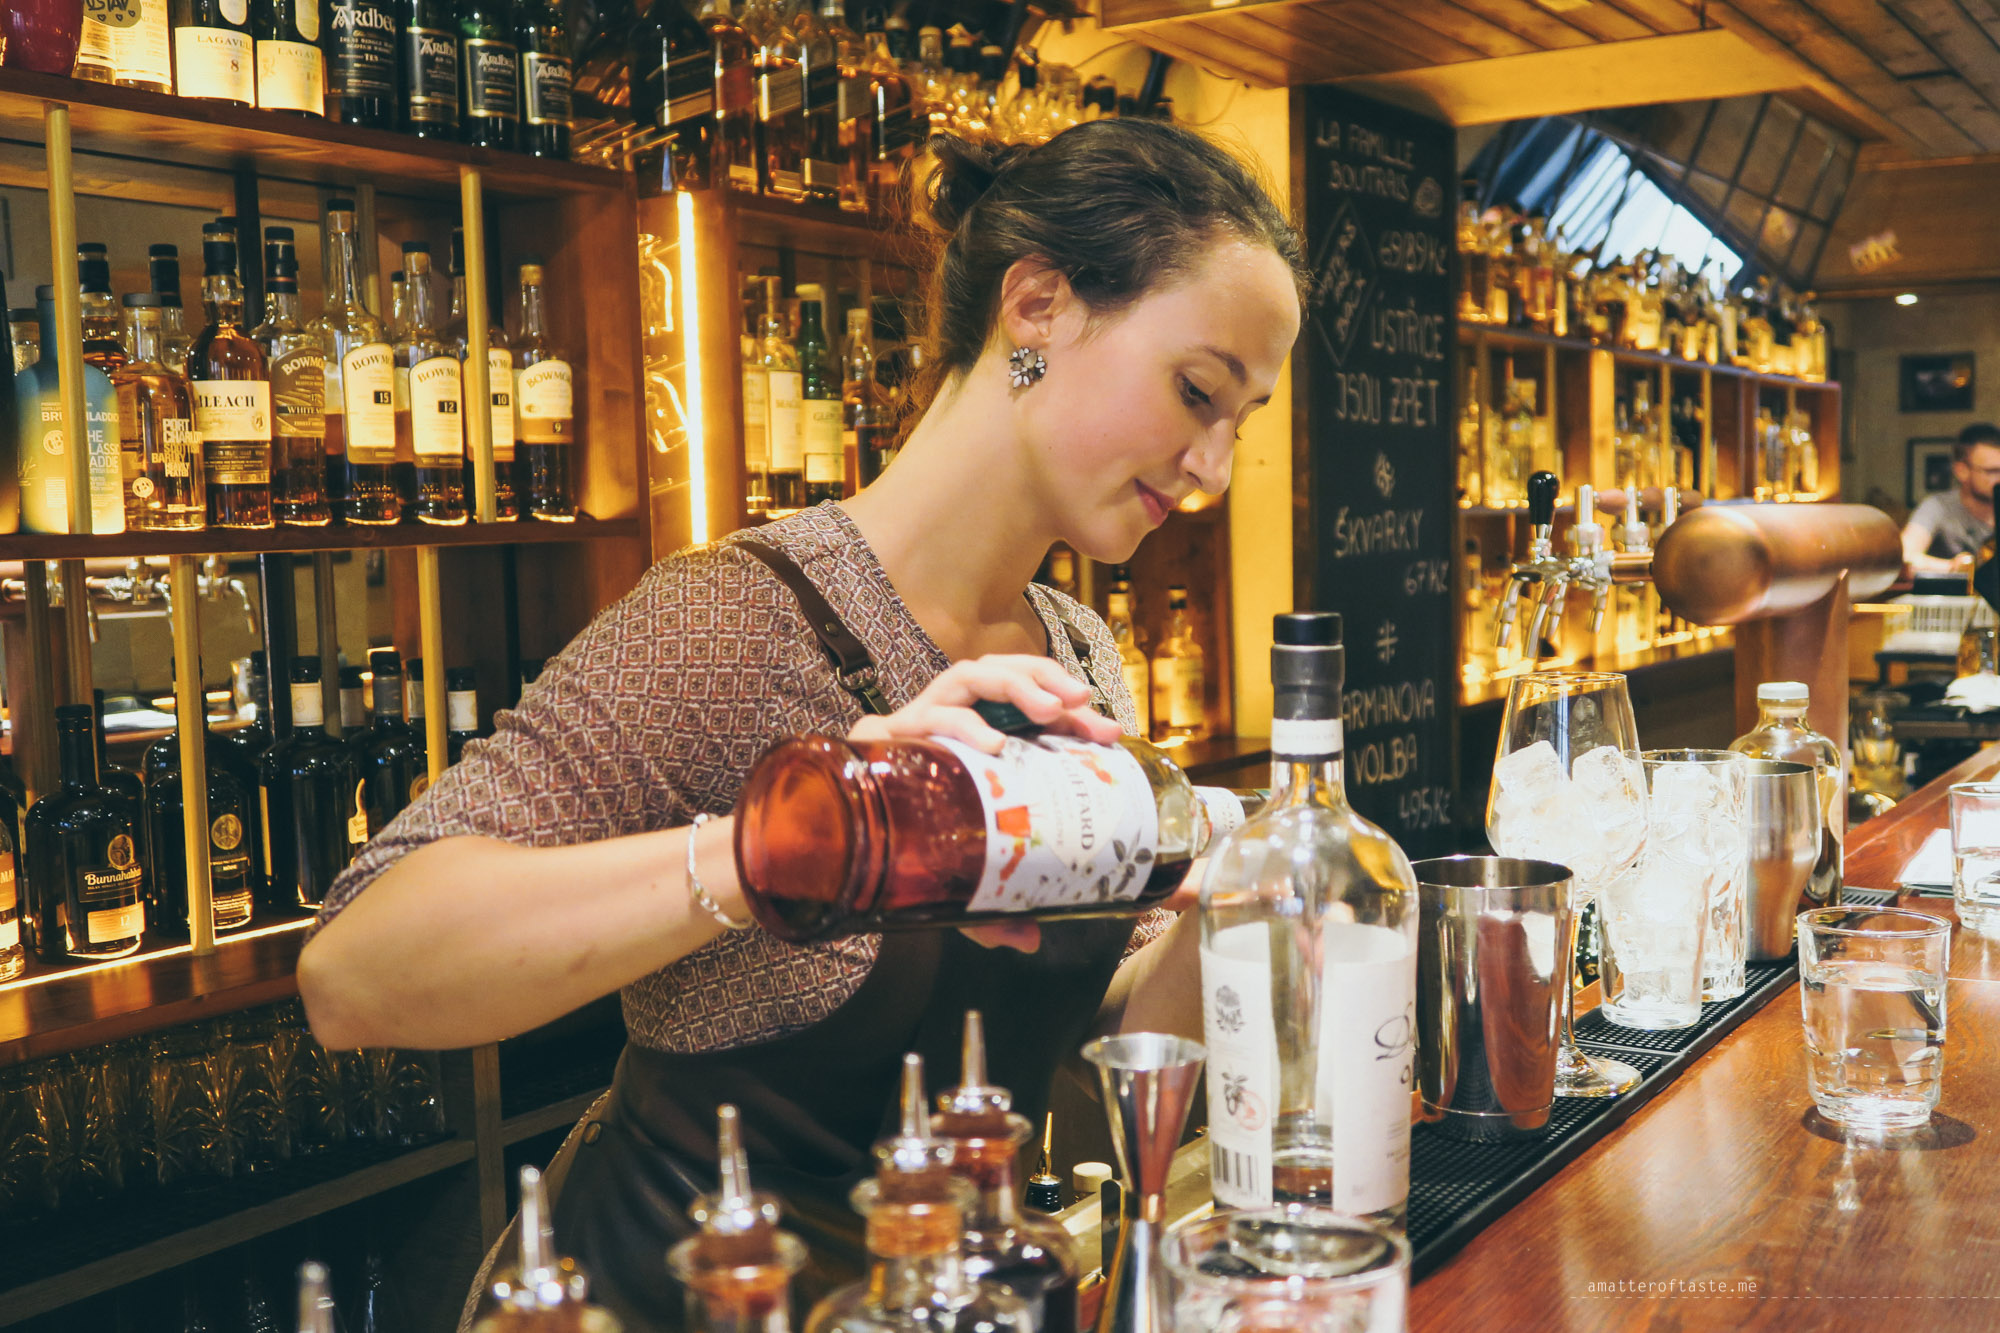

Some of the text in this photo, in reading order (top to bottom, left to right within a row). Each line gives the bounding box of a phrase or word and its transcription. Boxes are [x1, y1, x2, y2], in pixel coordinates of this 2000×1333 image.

[230, 59, 240, 73] 8
[379, 392, 390, 405] 15
[497, 394, 508, 404] 10
[443, 402, 455, 413] 12
[554, 422, 562, 434] 9
[87, 430, 103, 442] HE
[120, 915, 130, 927] 12
